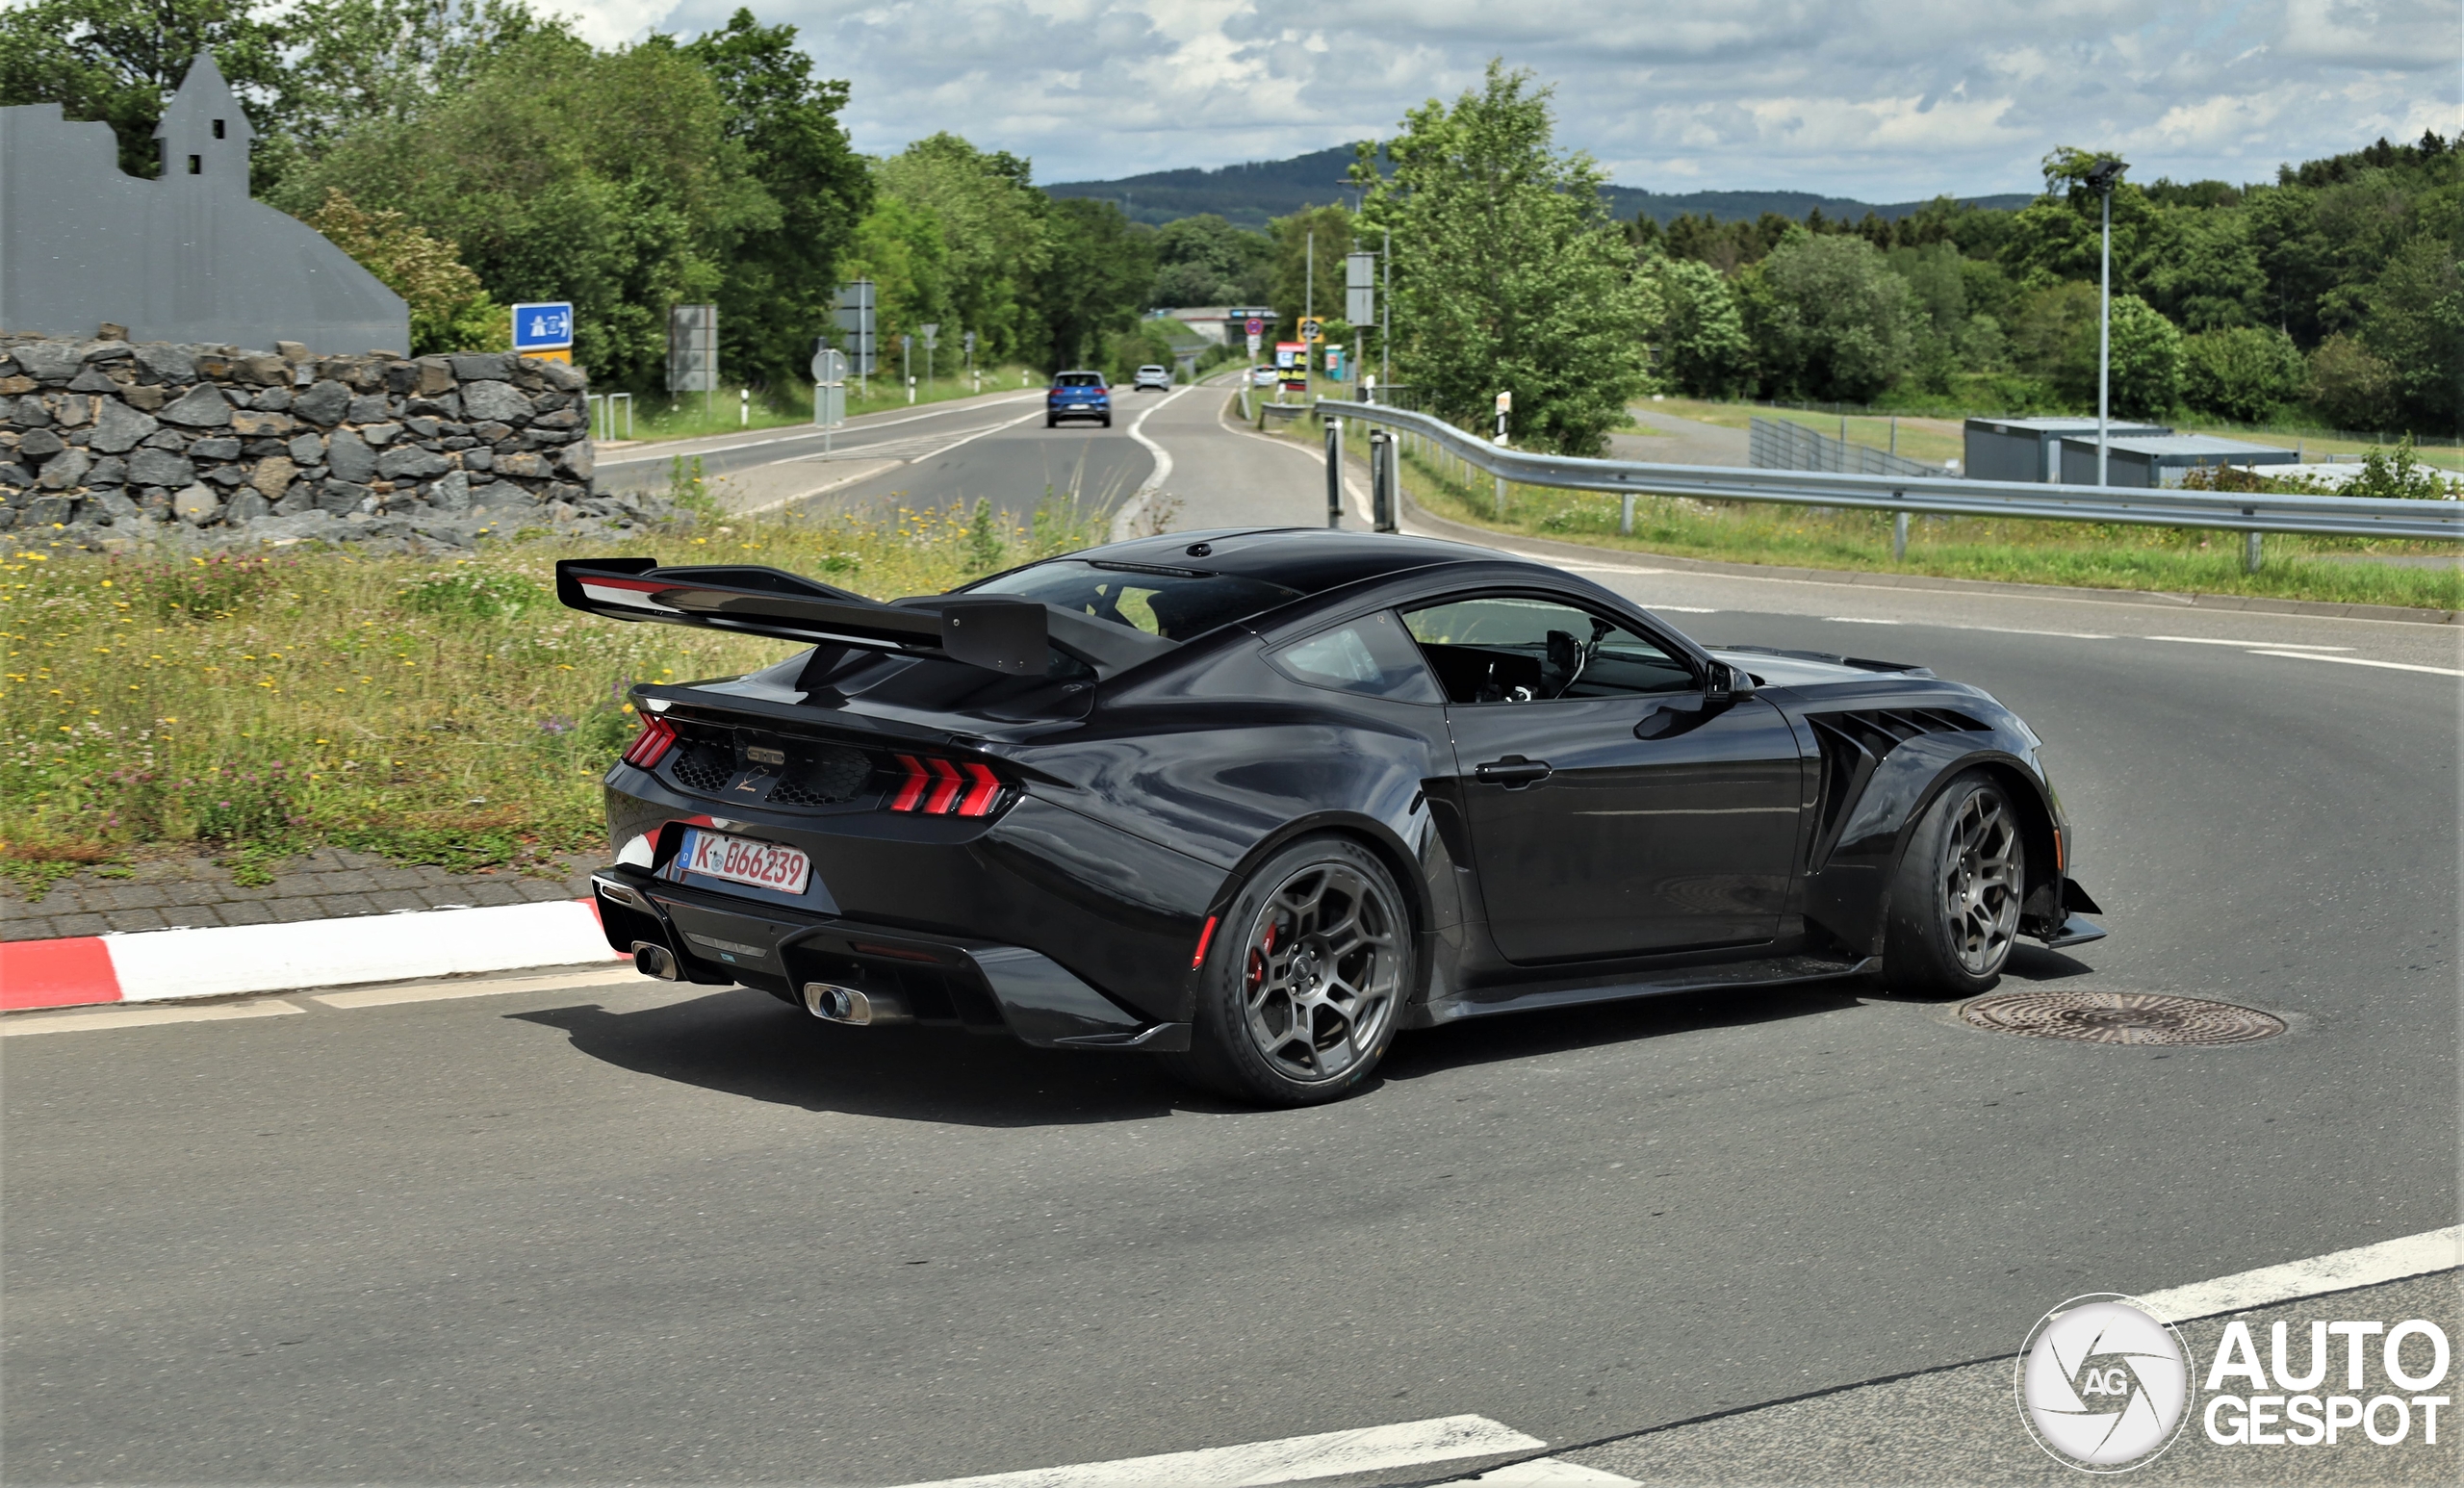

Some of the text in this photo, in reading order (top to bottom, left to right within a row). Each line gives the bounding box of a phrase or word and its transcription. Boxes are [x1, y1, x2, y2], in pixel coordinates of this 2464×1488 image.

[682, 852, 689, 861] D
[695, 835, 804, 886] K 066239
